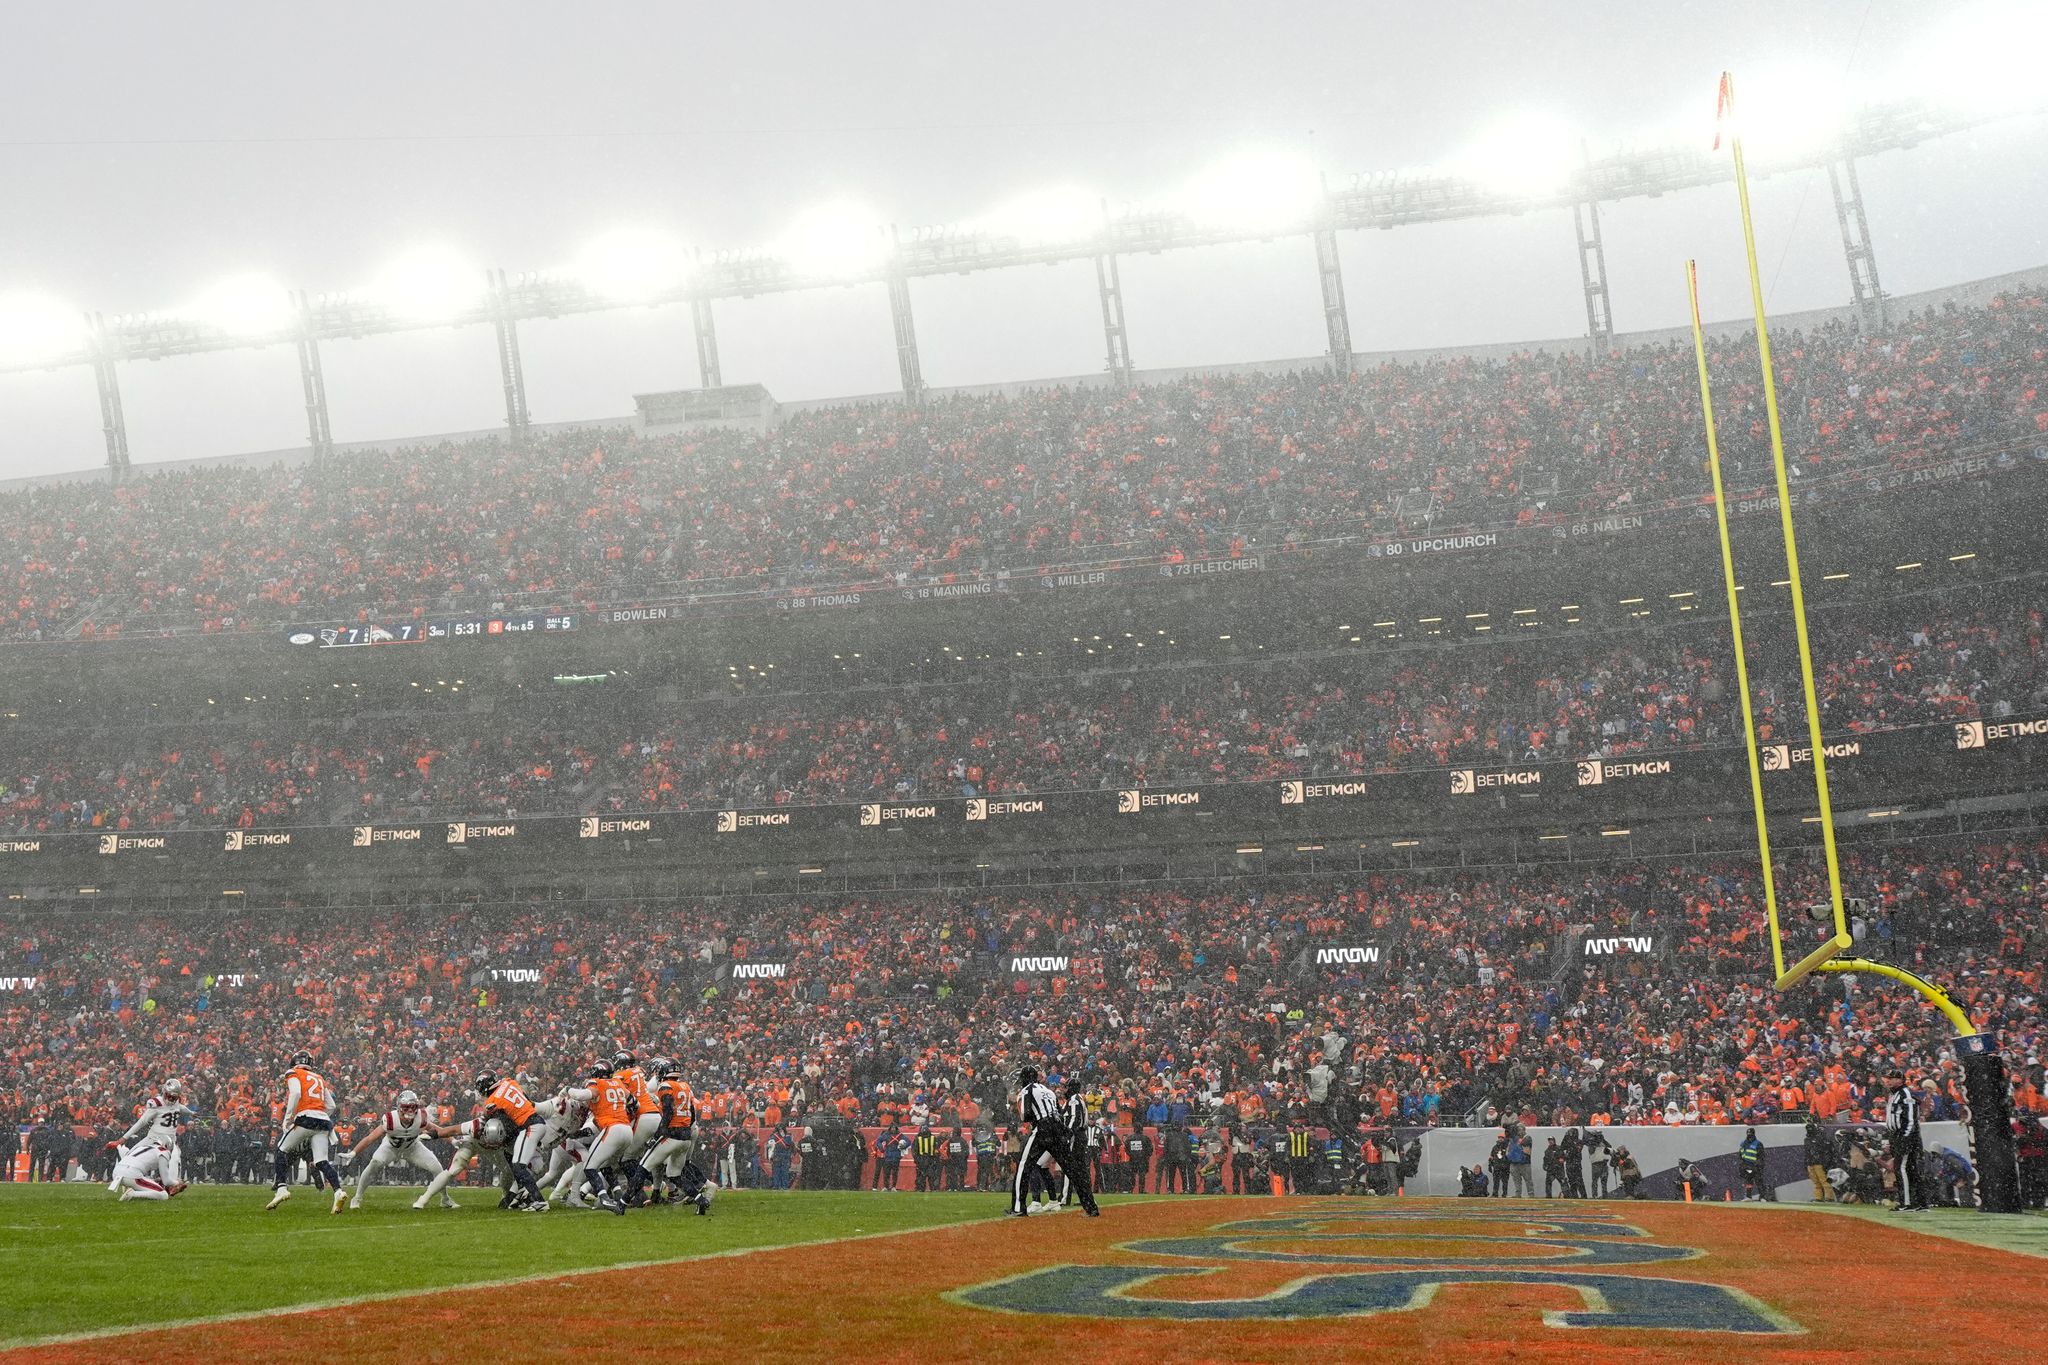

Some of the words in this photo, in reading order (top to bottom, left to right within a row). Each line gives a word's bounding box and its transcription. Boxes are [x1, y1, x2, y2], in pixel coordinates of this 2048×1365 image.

[1913, 458, 1988, 482] ATWATER
[1740, 494, 1799, 513] SHARE
[1571, 524, 1588, 536] 66
[1593, 516, 1642, 532] NALEN
[1386, 543, 1402, 555] 80
[1412, 534, 1496, 553] UPCHURCH
[1175, 564, 1191, 575] 73
[1193, 558, 1258, 574] FLETCHER
[1058, 572, 1105, 586] MILLER
[918, 589, 929, 598] 18
[934, 583, 991, 597] MANNING
[792, 598, 805, 608] 88
[811, 594, 860, 607] THOMAS
[562, 616, 570, 629] 5
[613, 608, 667, 622] BOWLEN
[349, 629, 358, 643] 7
[402, 626, 411, 640] 7
[429, 625, 444, 637] 3RD
[455, 622, 480, 635] 5:31
[1987, 719, 2048, 739] BETMG
[1791, 742, 1859, 762] BEMGM
[1604, 761, 1670, 778] BETMGM
[1477, 771, 1541, 787] BETMGM
[1306, 782, 1365, 797] BETMGM
[1142, 792, 1199, 806] BETMGM
[882, 806, 936, 819] BETMGM
[988, 800, 1043, 814] BETMGM
[600, 820, 650, 832] BETMGM
[738, 814, 790, 827] BETMGM
[373, 829, 421, 841] BETMGM
[467, 825, 515, 838] BETMGM
[119, 838, 164, 849] BETMGM
[244, 834, 290, 845] BETMGM
[1316, 947, 1379, 964] ARROW
[733, 964, 786, 978] ARROW
[1011, 956, 1069, 972] ARROW
[307, 1075, 325, 1101] 21
[504, 1084, 532, 1109] 51
[606, 1088, 627, 1111] 99
